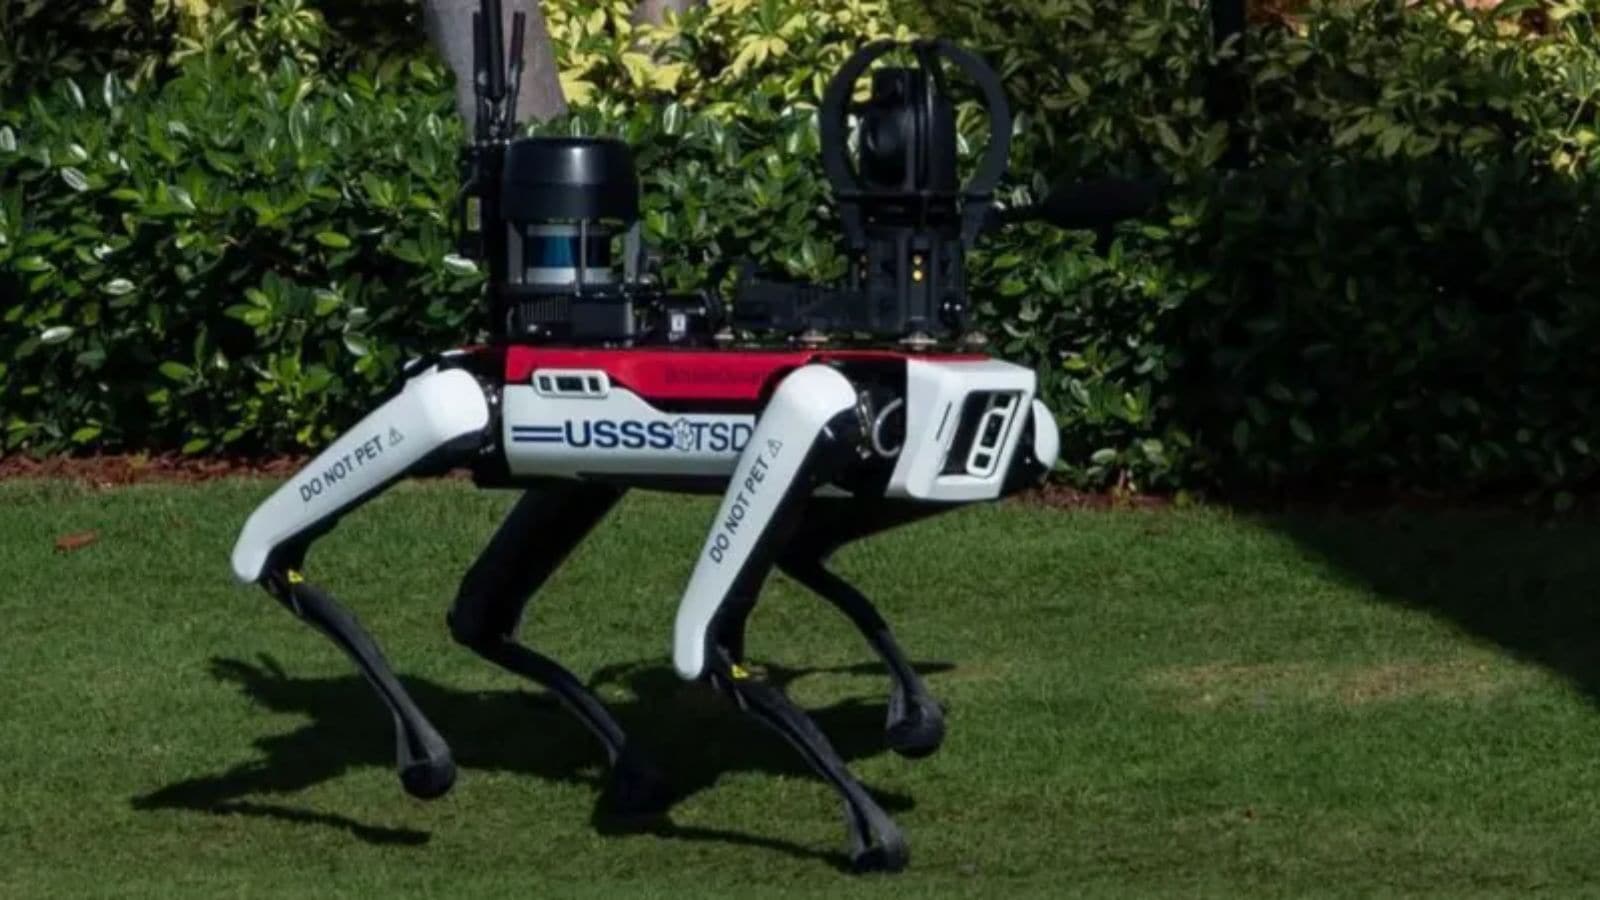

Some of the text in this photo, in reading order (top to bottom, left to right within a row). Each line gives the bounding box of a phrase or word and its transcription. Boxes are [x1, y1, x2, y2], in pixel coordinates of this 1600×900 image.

[299, 434, 383, 502] DO NOT PET
[564, 420, 753, 452] USSS TSD
[709, 454, 769, 564] DO NOT PET
